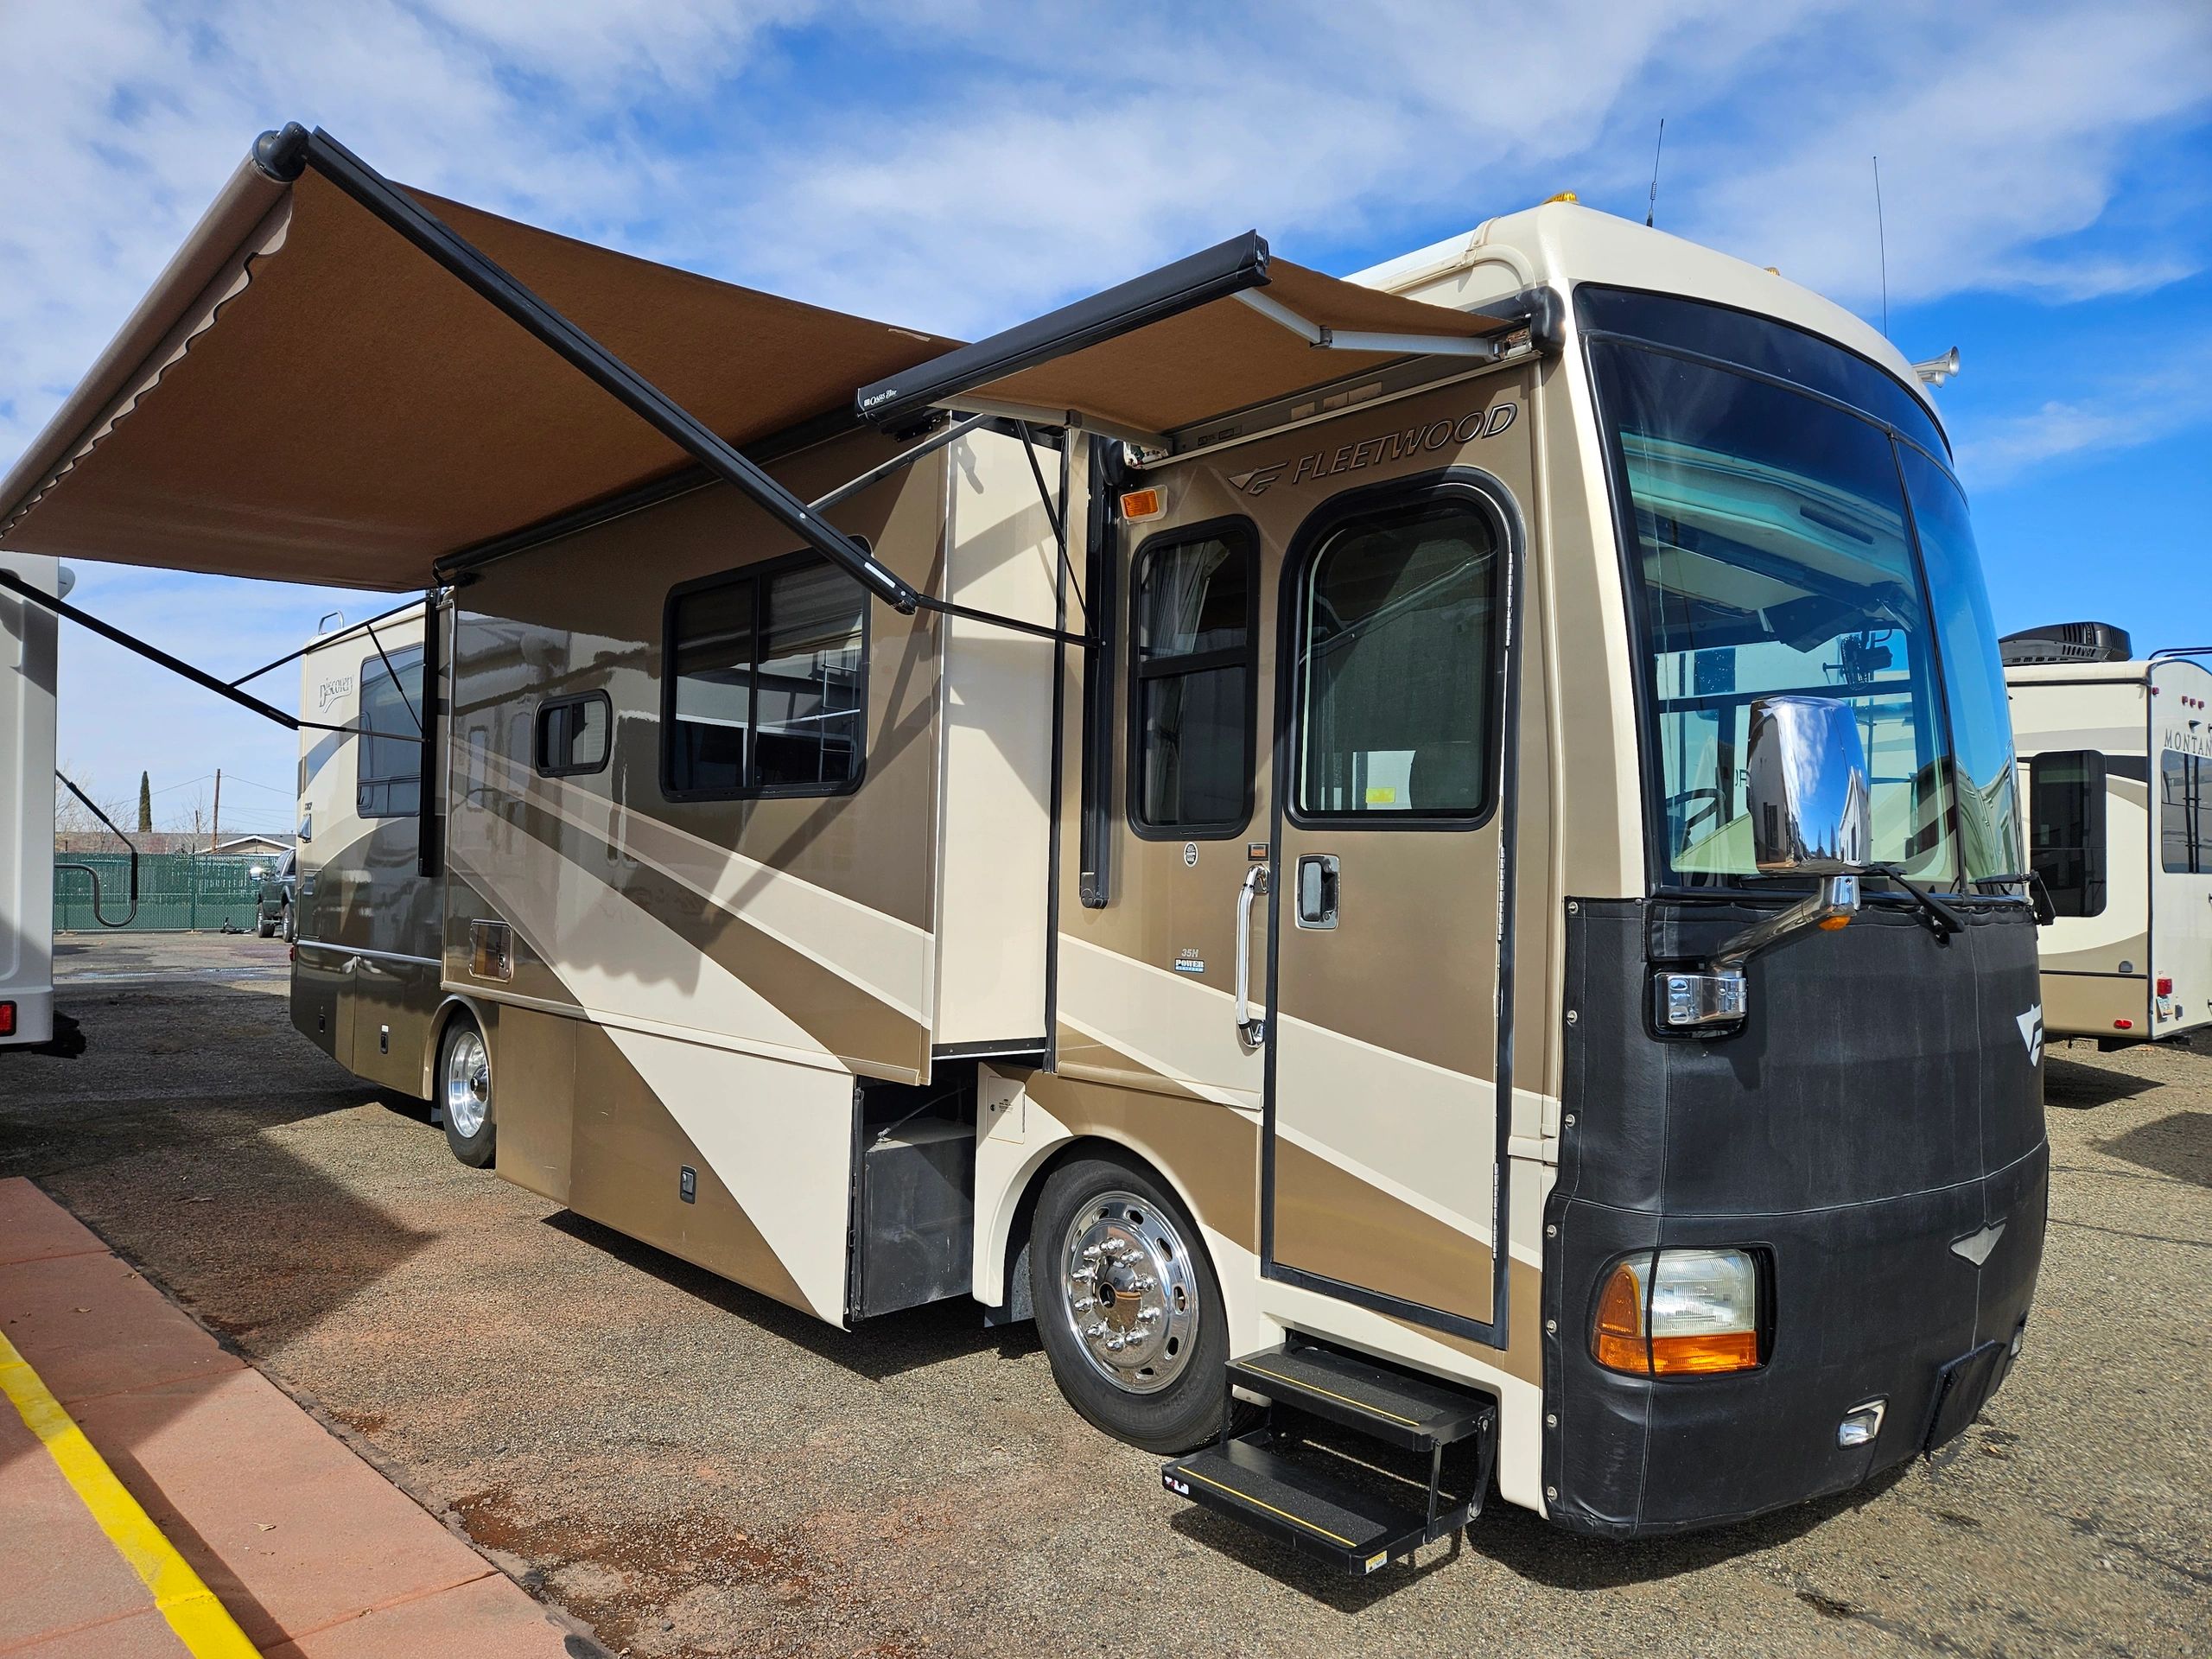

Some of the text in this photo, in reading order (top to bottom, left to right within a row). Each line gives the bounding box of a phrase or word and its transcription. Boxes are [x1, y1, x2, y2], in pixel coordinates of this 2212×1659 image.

[1292, 402, 1518, 485] FLEETWOOD
[1181, 948, 1199, 958] 35H
[1175, 959, 1205, 968] POWER
